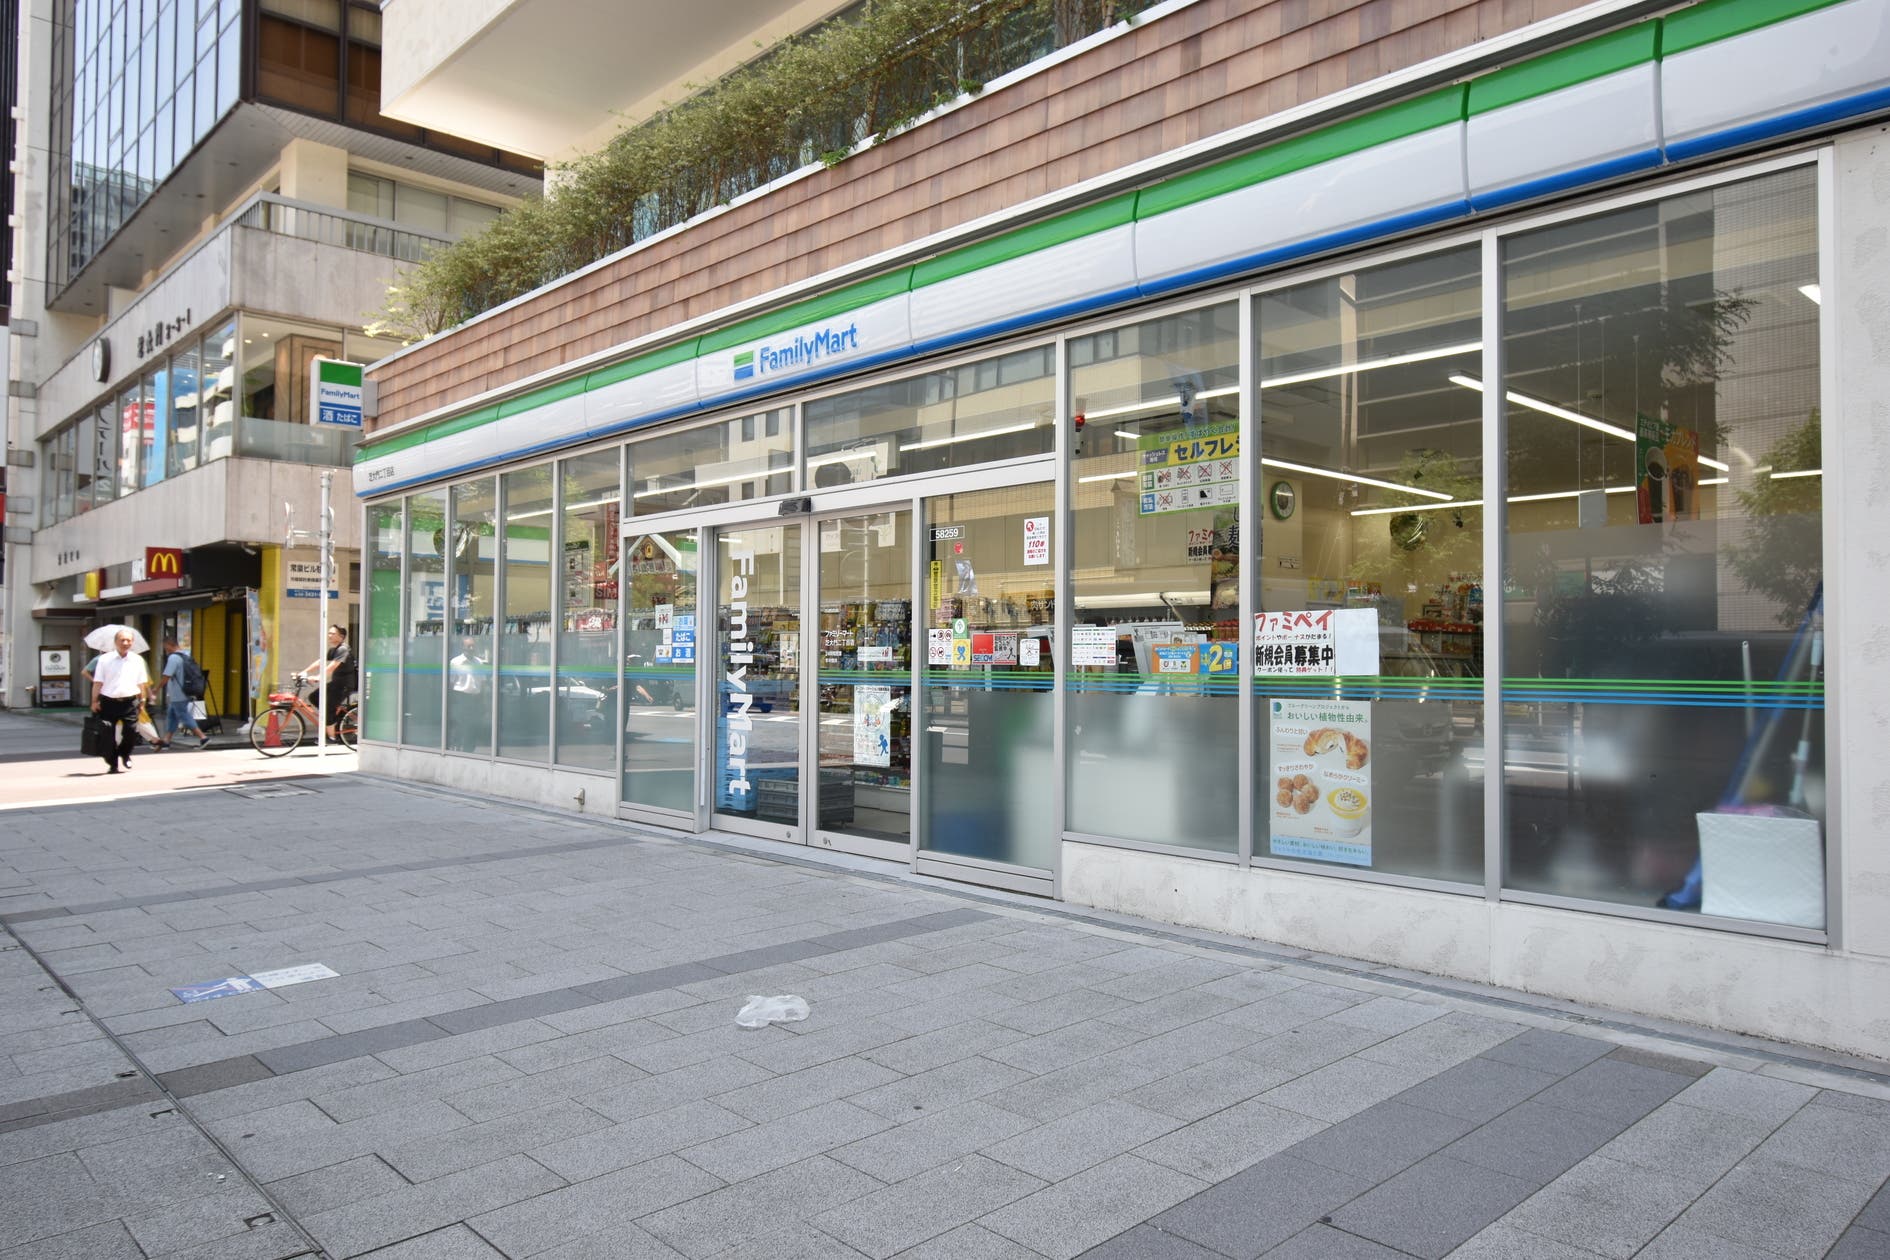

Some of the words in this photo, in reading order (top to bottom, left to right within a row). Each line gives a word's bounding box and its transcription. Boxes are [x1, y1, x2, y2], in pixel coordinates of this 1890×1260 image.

[760, 322, 858, 373] FamilyMart
[320, 388, 361, 400] FamilyMart
[322, 409, 333, 422] 酒
[336, 412, 358, 424] たばこ
[1174, 434, 1240, 461] セルフレ
[935, 528, 959, 539] 58259
[1255, 609, 1334, 632] ファミペイ
[1255, 644, 1334, 667] 新規会員募集中
[726, 549, 755, 796] FamilyMart
